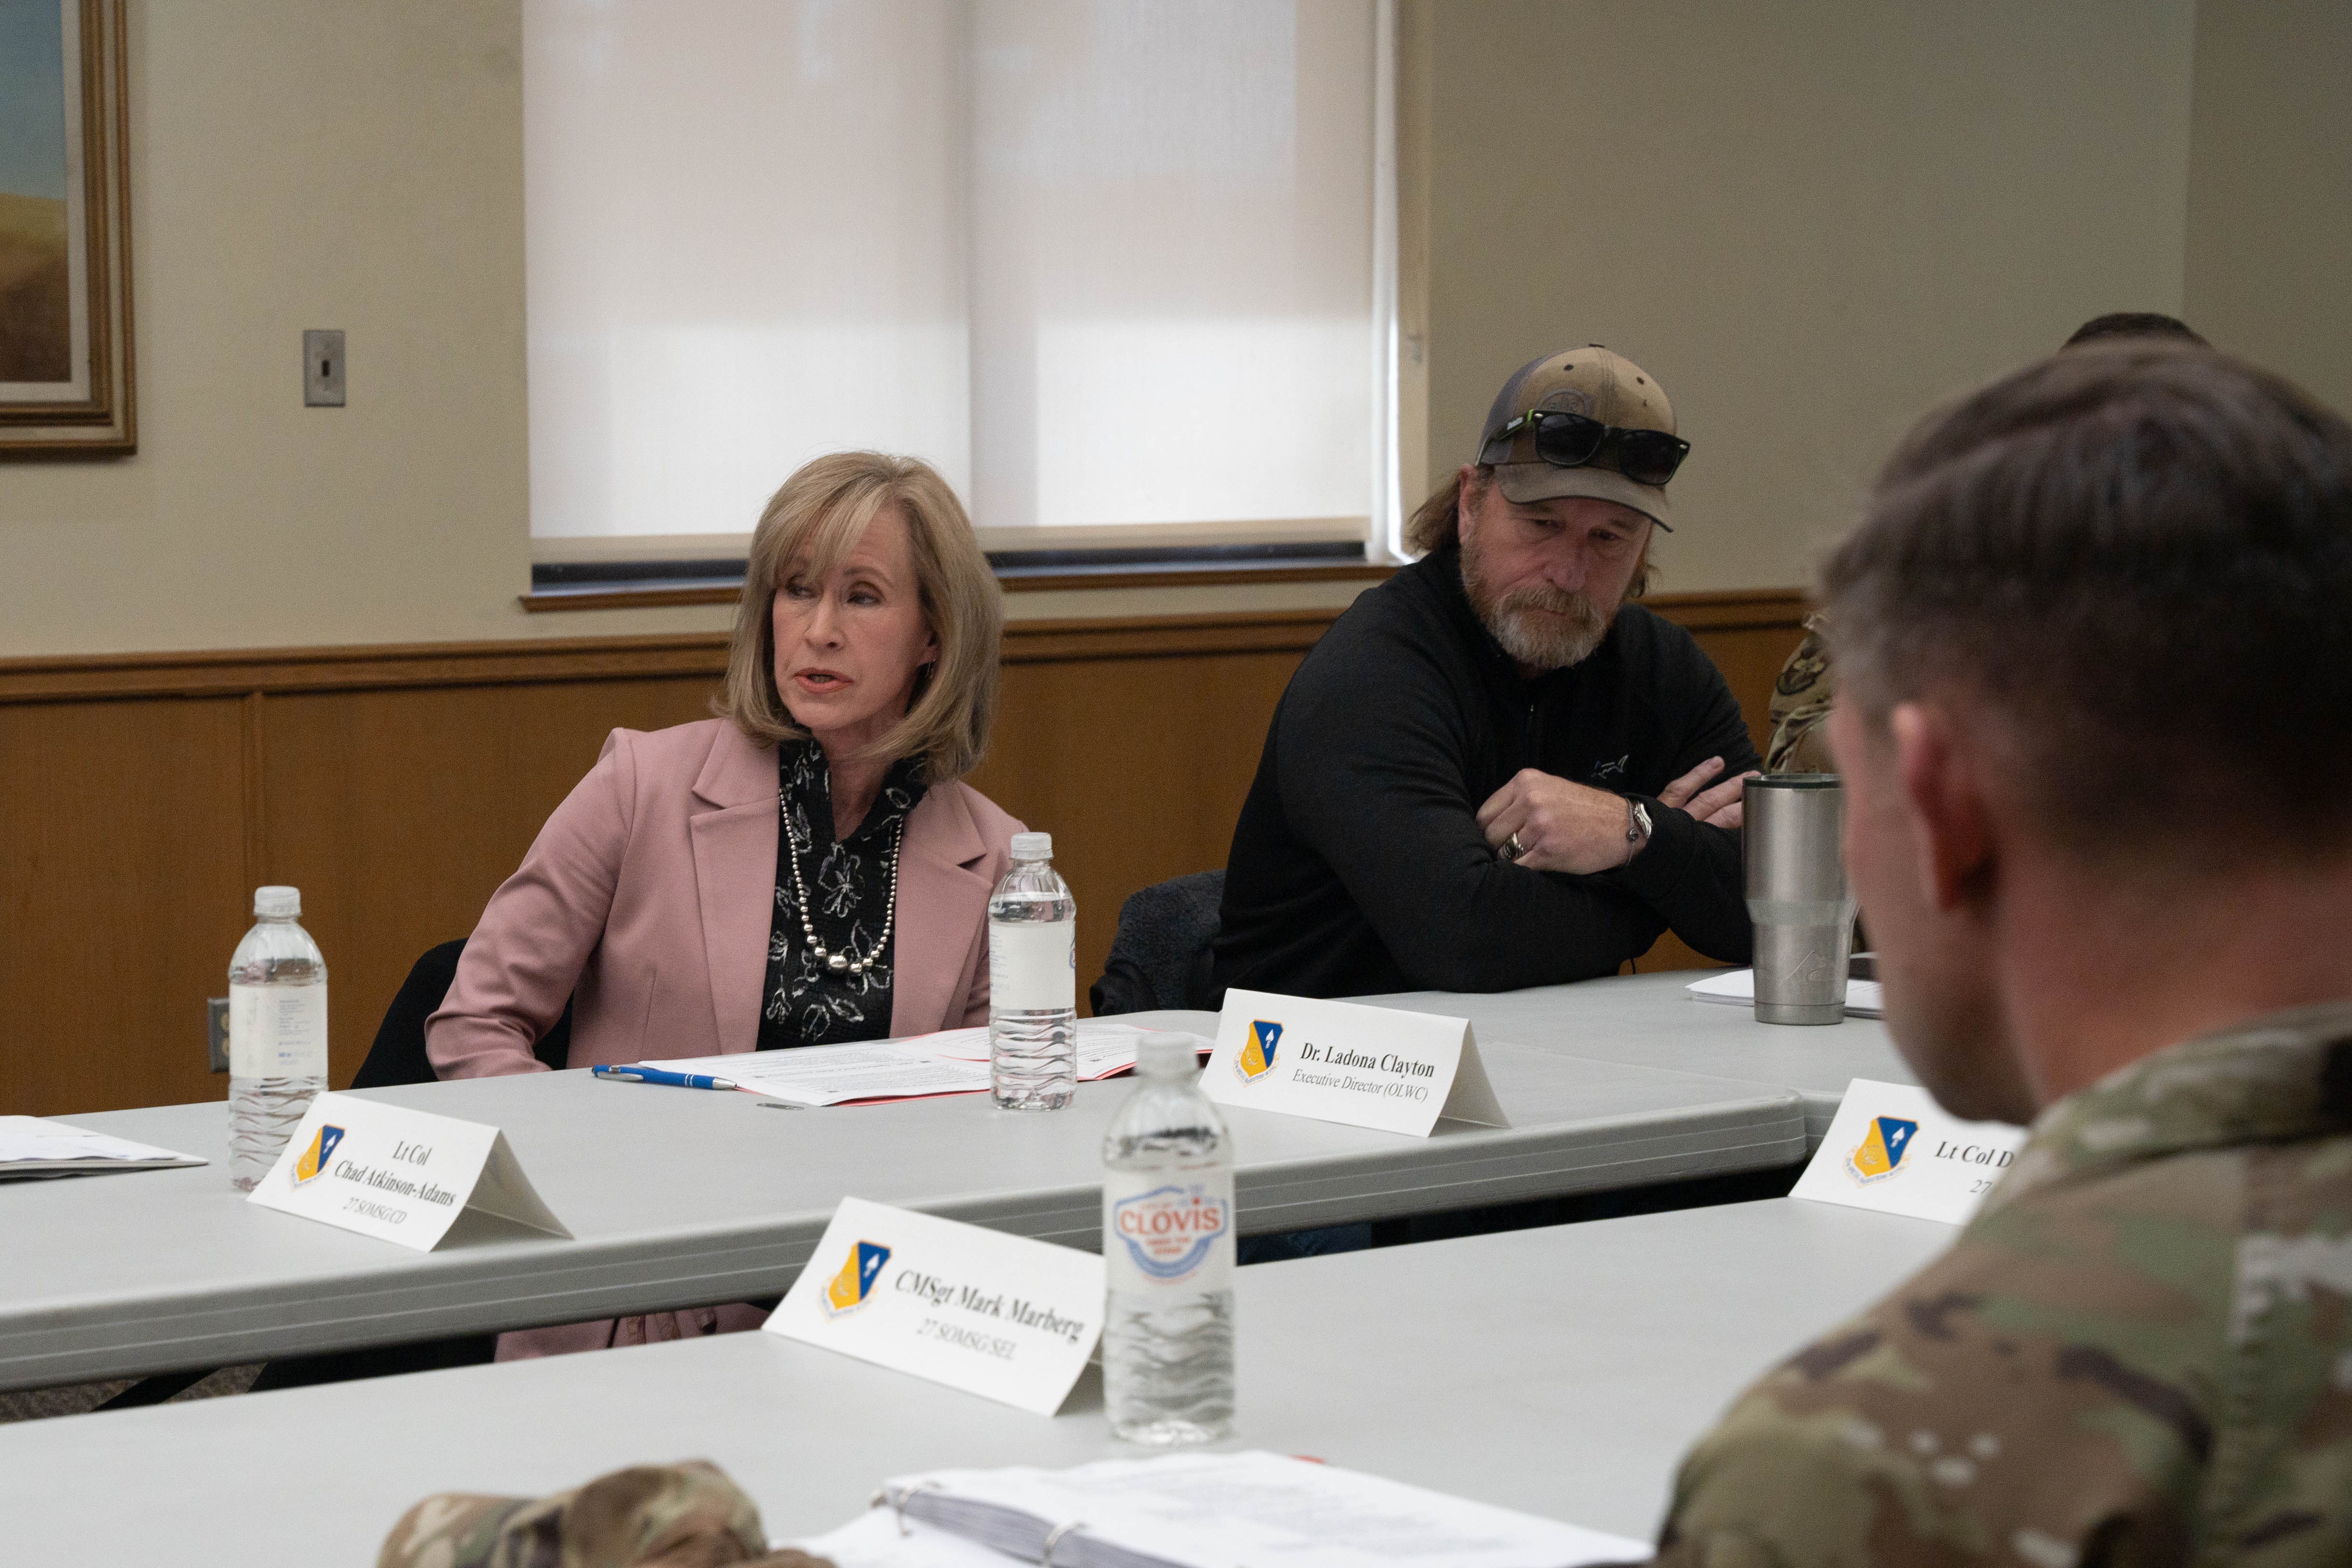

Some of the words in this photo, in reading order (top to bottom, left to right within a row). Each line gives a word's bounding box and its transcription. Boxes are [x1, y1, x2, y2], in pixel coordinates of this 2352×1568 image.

[1300, 1042, 1320, 1061] Dr.
[1325, 1046, 1376, 1069] Ladona
[1381, 1054, 1435, 1079] Clayton
[1292, 1069, 1340, 1087] Executive
[1341, 1076, 1385, 1094] Director
[1383, 1082, 1428, 1103] (OLWC)
[392, 1140, 409, 1161] Lt
[409, 1144, 432, 1166] Col
[1935, 1141, 1958, 1159] Lt
[1962, 1145, 1996, 1165] Col
[334, 1159, 369, 1182] Chad
[363, 1169, 457, 1207] Atkinson-Adams
[342, 1197, 360, 1210] 27
[1119, 1207, 1219, 1235] CLOVIS
[895, 1269, 955, 1307] CMSgt
[955, 1285, 1004, 1317] Mark
[1005, 1298, 1085, 1344] Marberg
[917, 1317, 939, 1335] 27
